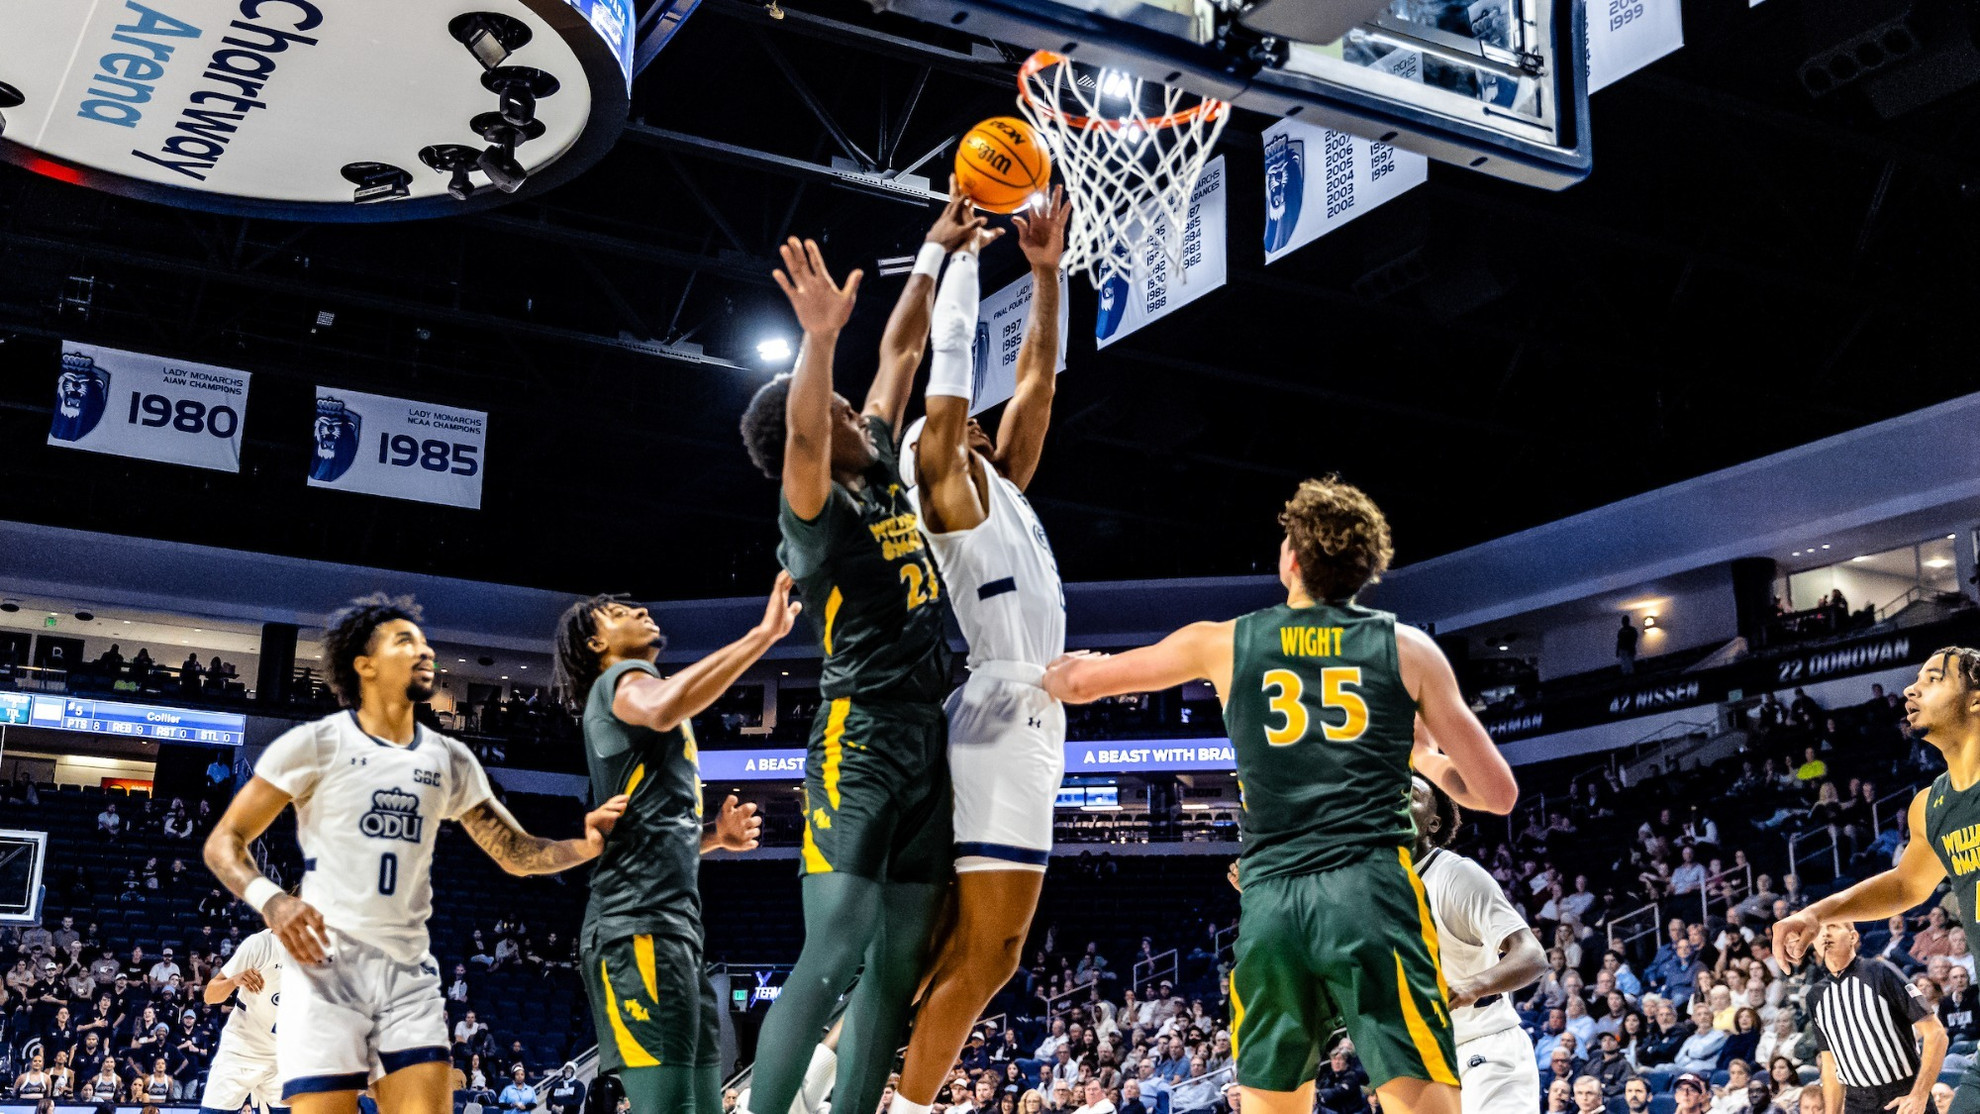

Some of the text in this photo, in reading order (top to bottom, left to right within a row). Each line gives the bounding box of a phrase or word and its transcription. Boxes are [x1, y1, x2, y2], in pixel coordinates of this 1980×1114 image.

[1609, 0, 1639, 16] 20
[1610, 4, 1644, 32] 1999
[77, 0, 203, 128] Arena
[131, 0, 324, 182] Chartway
[1325, 144, 1353, 168] 2006
[1371, 147, 1394, 169] 1997
[1326, 157, 1354, 180] 2005
[1372, 160, 1395, 182] 1996
[1326, 170, 1354, 193] 2004
[1327, 183, 1354, 206] 2003
[1327, 196, 1354, 219] 2002
[1184, 252, 1202, 270] 982
[993, 307, 1008, 320] FINAL
[1008, 297, 1024, 312] FOUR
[1146, 296, 1167, 314] 1988
[1003, 319, 1022, 339] 1997
[1003, 333, 1022, 353] 1985
[1003, 347, 1020, 367] 198
[162, 366, 244, 387] LADY MONARCHS
[162, 375, 243, 396] AIAW CHAMPIONS
[128, 391, 239, 439] 1980
[407, 417, 482, 435] NCAA CHAMPIONS
[408, 407, 482, 428] LADY MONARCHS
[378, 432, 479, 477] 1985
[1280, 626, 1345, 657] WIGHT
[1778, 637, 1910, 682] 22 DONOVAN
[1261, 666, 1370, 747] 35
[1635, 681, 1700, 710] NISSEN
[146, 711, 182, 724] Collier
[67, 718, 88, 730] PTS
[93, 721, 101, 731] 8
[112, 722, 133, 734] REB
[136, 724, 144, 735] 9
[180, 729, 188, 739] 0
[200, 730, 219, 742] STL
[223, 733, 231, 743] 0
[744, 757, 806, 771] A BEAST
[1083, 750, 1096, 764] A
[1098, 749, 1151, 764] BEAST
[1152, 748, 1195, 762] WITH
[413, 768, 441, 788] SBC
[360, 809, 424, 844] ODU
[378, 851, 398, 896] 0
